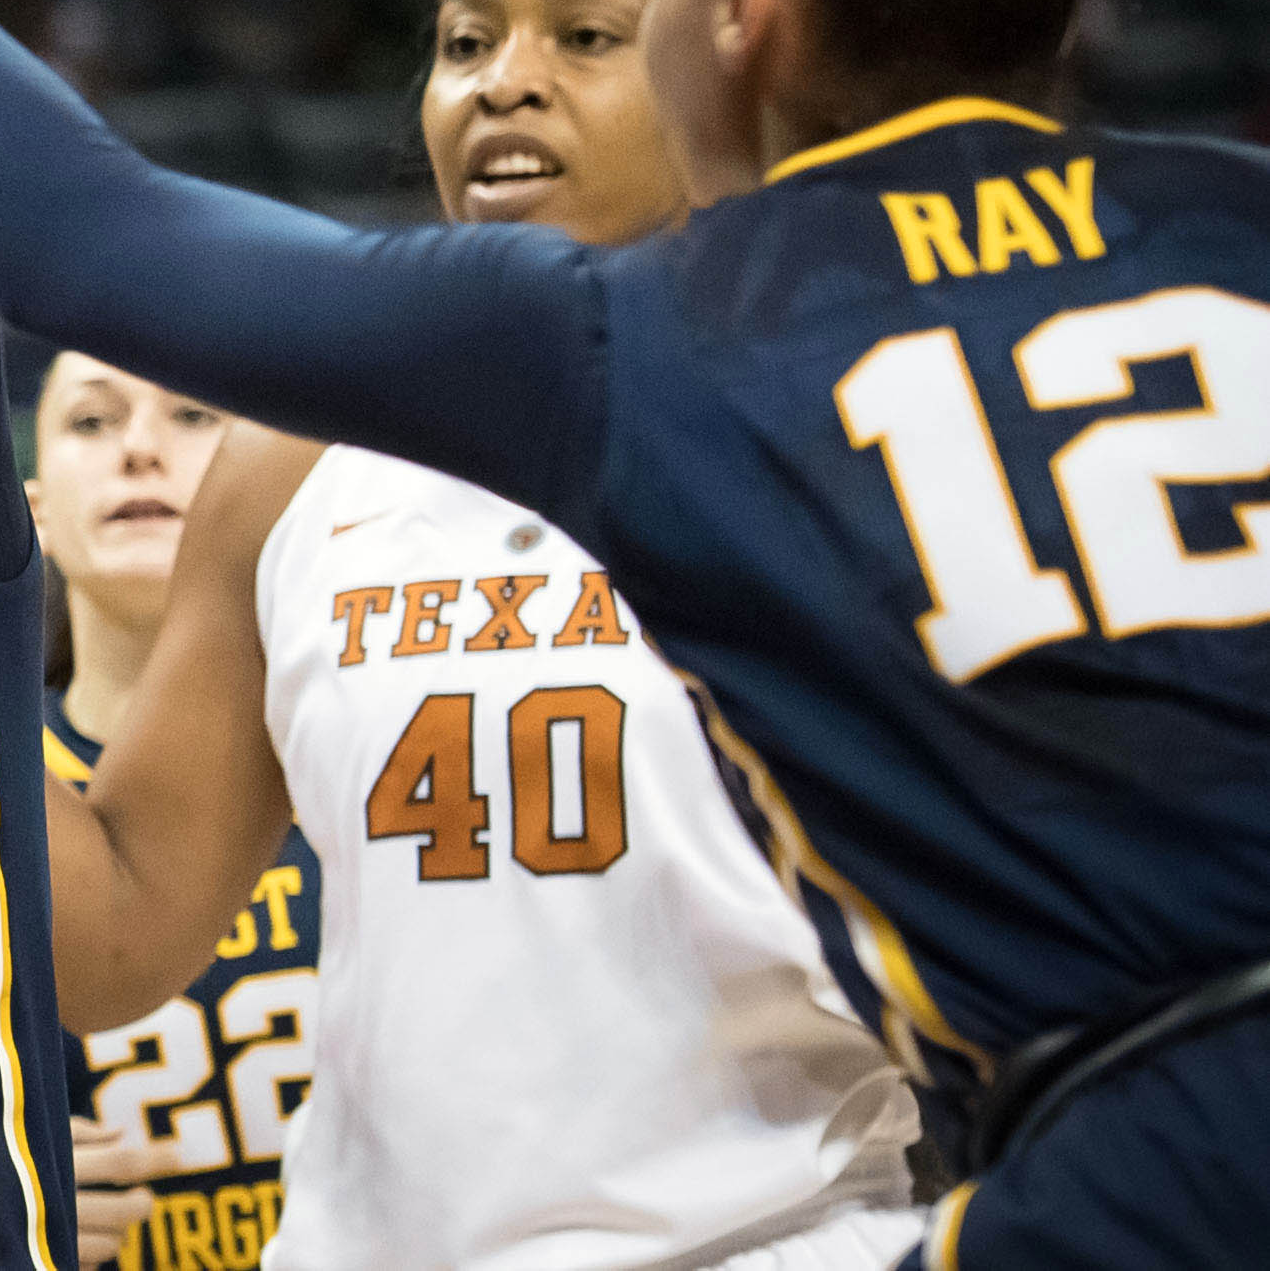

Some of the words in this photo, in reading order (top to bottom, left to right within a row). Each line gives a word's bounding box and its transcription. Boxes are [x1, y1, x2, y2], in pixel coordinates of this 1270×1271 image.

[879, 157, 1106, 283] RAY
[831, 285, 1270, 685] 12
[331, 570, 629, 668] TEXA
[366, 684, 629, 883] 40
[83, 967, 319, 1177] 22
